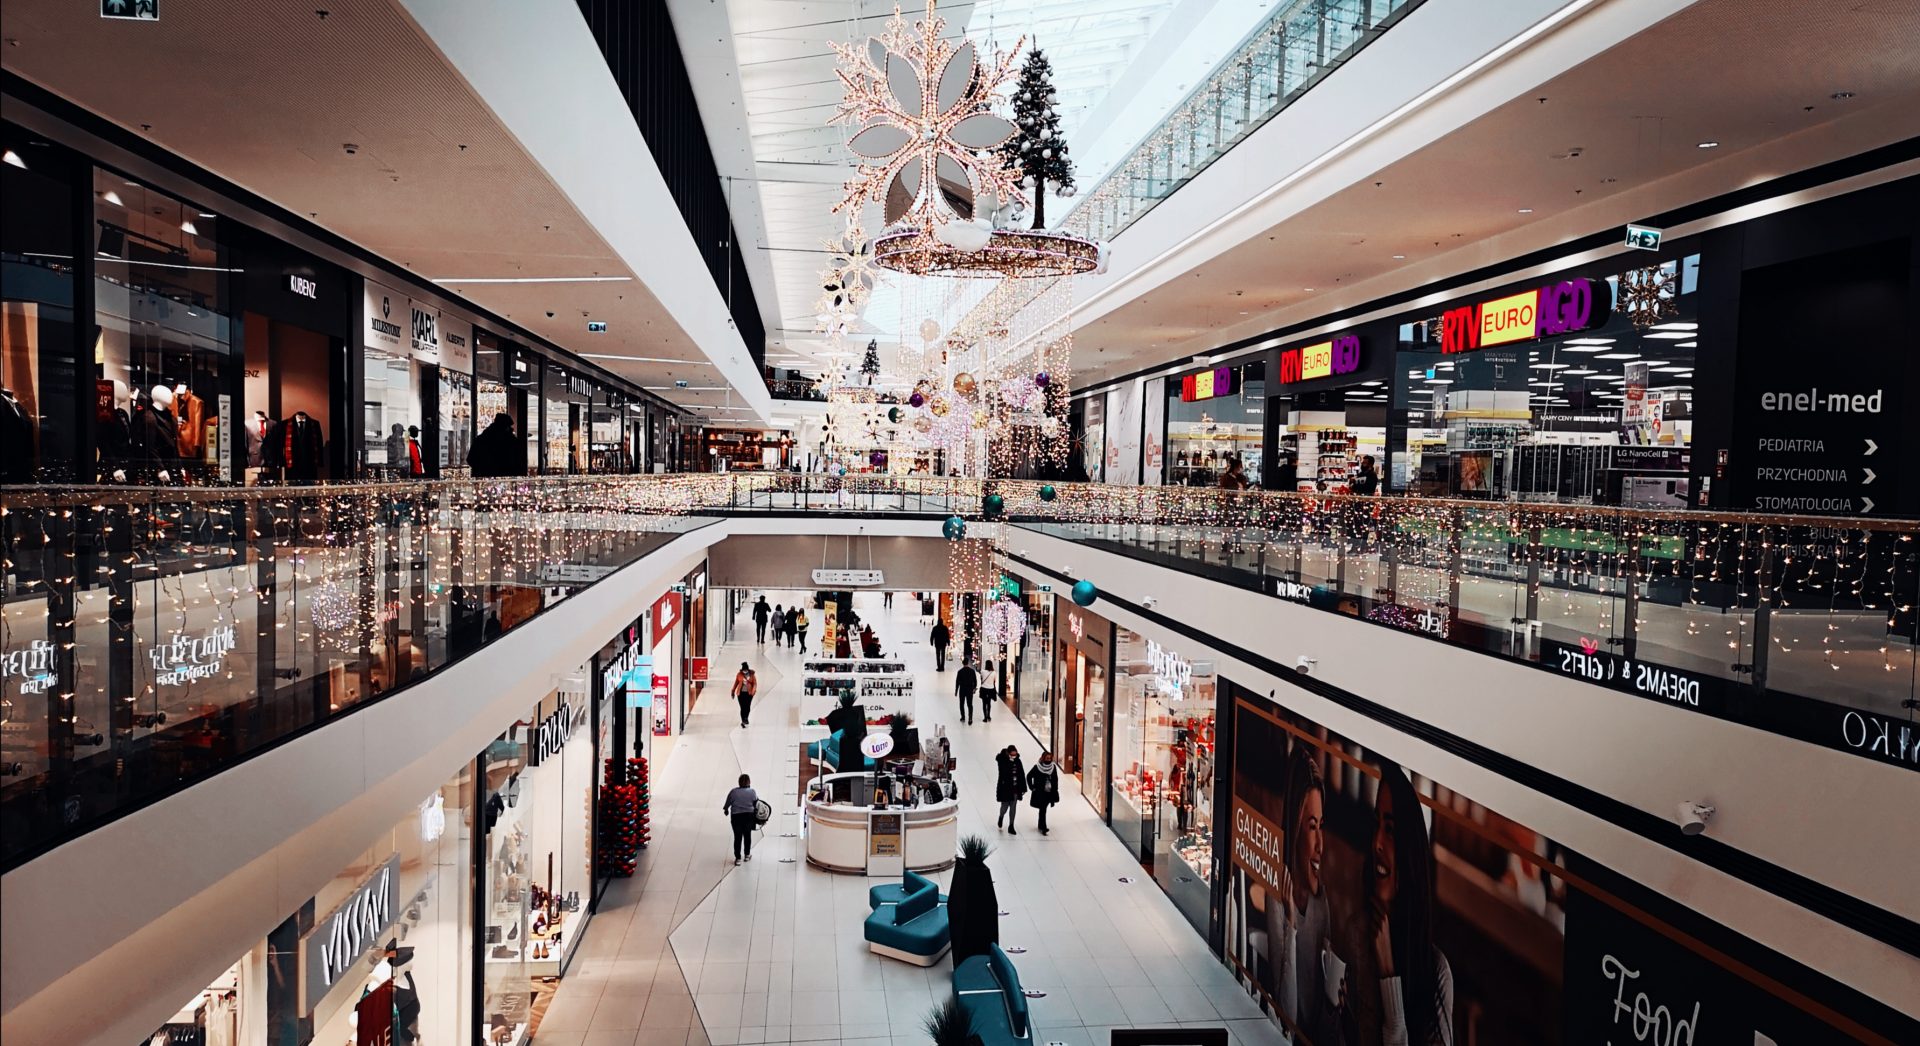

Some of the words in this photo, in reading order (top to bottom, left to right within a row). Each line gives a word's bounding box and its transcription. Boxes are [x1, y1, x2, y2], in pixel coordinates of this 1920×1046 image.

[290, 274, 317, 300] KUBENZ
[1441, 303, 1483, 355] RTV
[1483, 304, 1533, 334] EURO
[1535, 277, 1593, 338] AGD
[1281, 347, 1304, 384] RTV
[1303, 351, 1330, 371] EURO
[1331, 335, 1361, 375] AGD
[244, 369, 260, 378] ENZ
[1761, 387, 1883, 413] enel-med
[1617, 449, 1628, 457] LG
[1629, 449, 1661, 458] NanoCell
[1758, 438, 1825, 452] PEDIATRIA
[1757, 467, 1848, 482] PRZYCHODNIA
[1755, 496, 1852, 511] STOMATOLOGIA
[1236, 807, 1280, 864] GALERIA
[1235, 837, 1279, 892] PÓŁNOCNA
[1602, 954, 1700, 1046] Food
